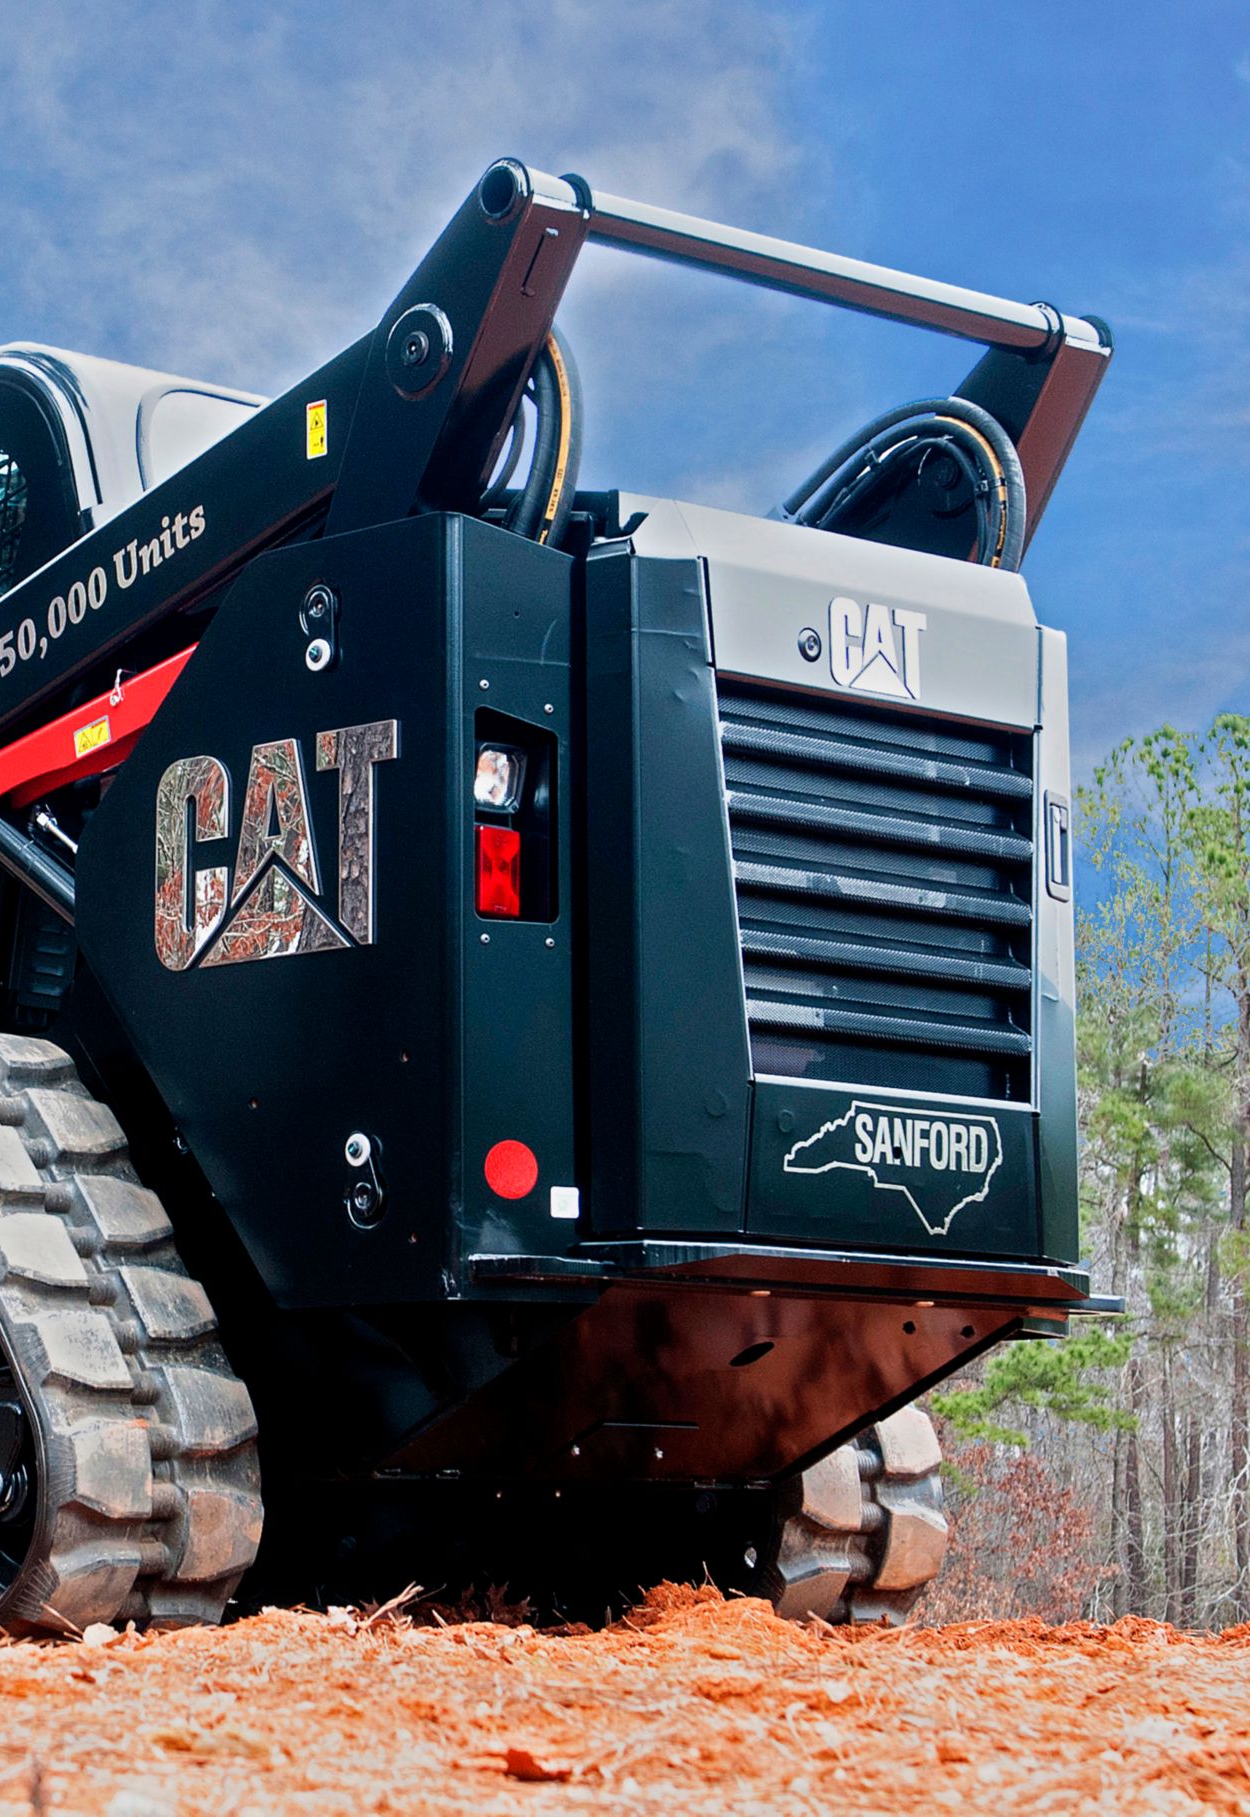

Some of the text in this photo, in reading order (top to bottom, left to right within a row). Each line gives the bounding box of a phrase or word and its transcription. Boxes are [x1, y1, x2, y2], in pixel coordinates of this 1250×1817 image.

[113, 504, 206, 589] Units
[829, 596, 927, 700] CAT
[154, 719, 400, 971] CAT
[854, 1113, 988, 1173] SANFORD
